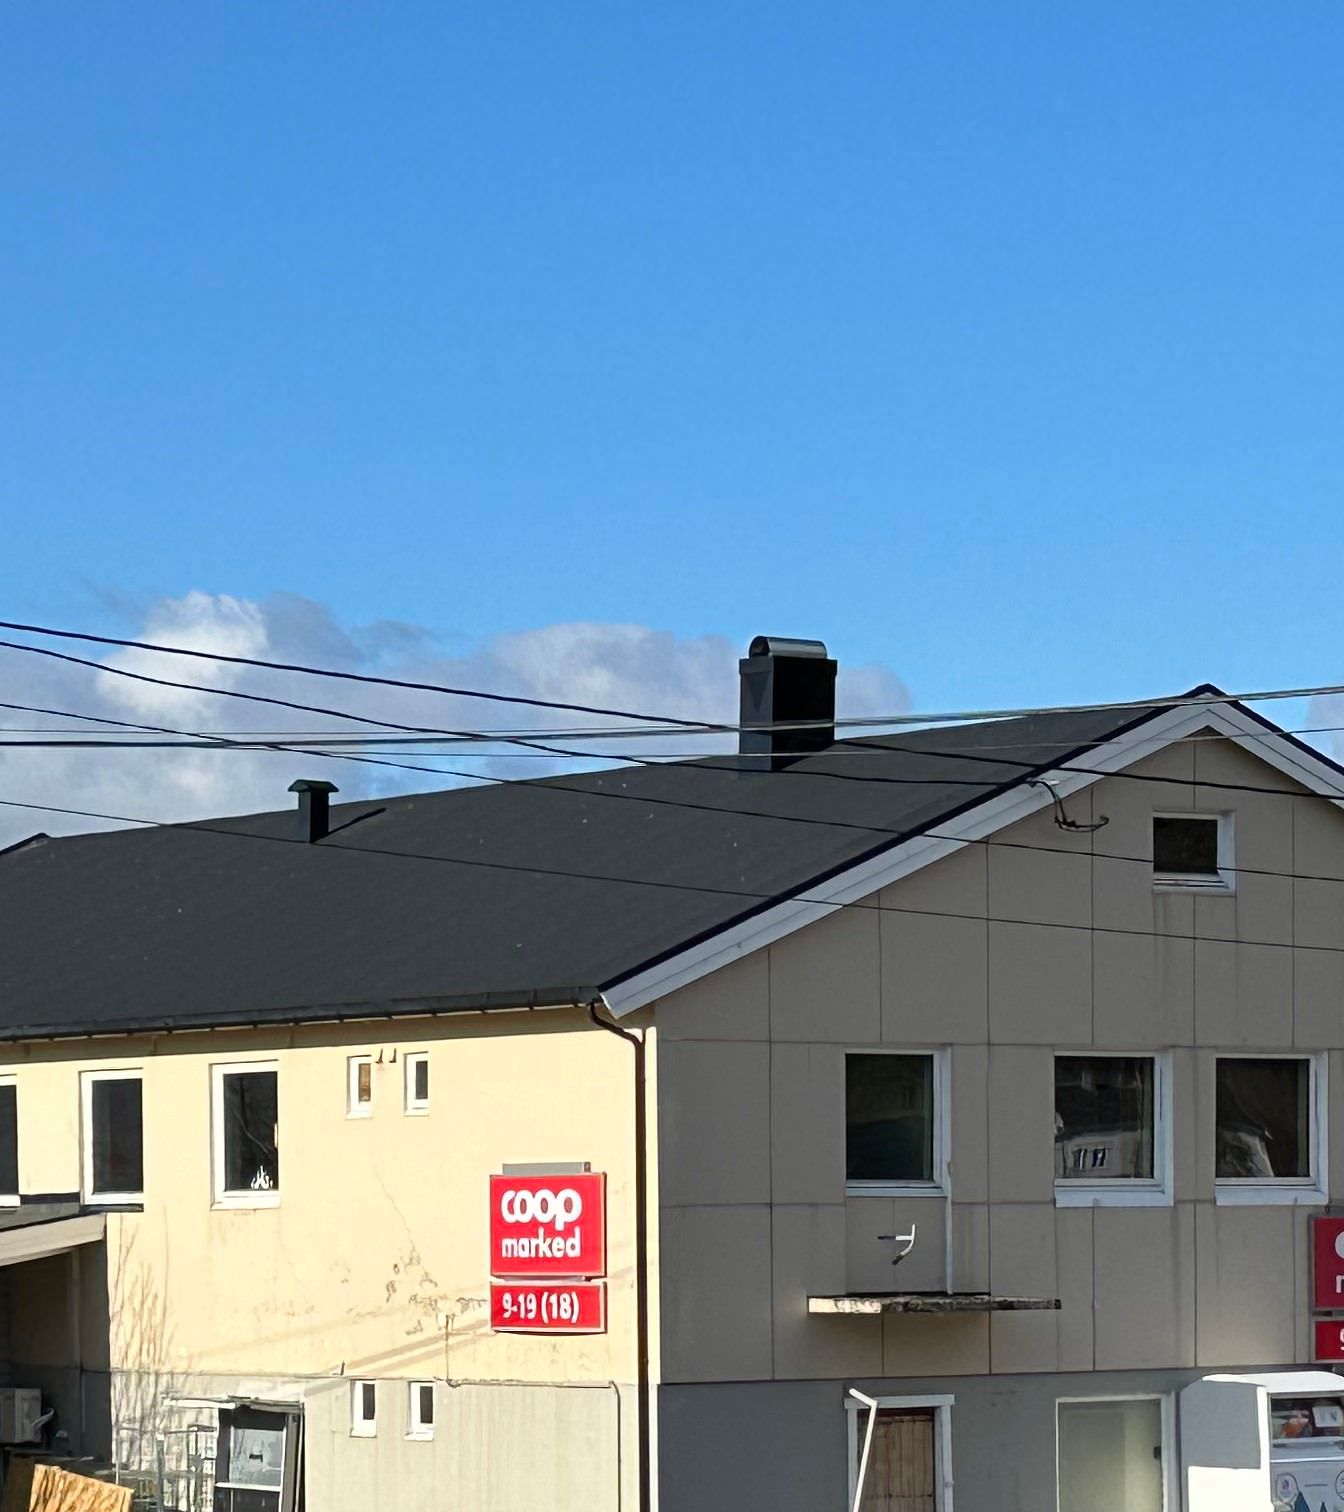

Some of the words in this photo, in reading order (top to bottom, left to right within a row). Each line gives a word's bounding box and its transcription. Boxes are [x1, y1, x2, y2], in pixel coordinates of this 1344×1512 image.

[501, 1188, 583, 1231] coop
[501, 1226, 581, 1258] marked
[502, 1293, 537, 1319] 9-19
[541, 1292, 580, 1323] (18)
